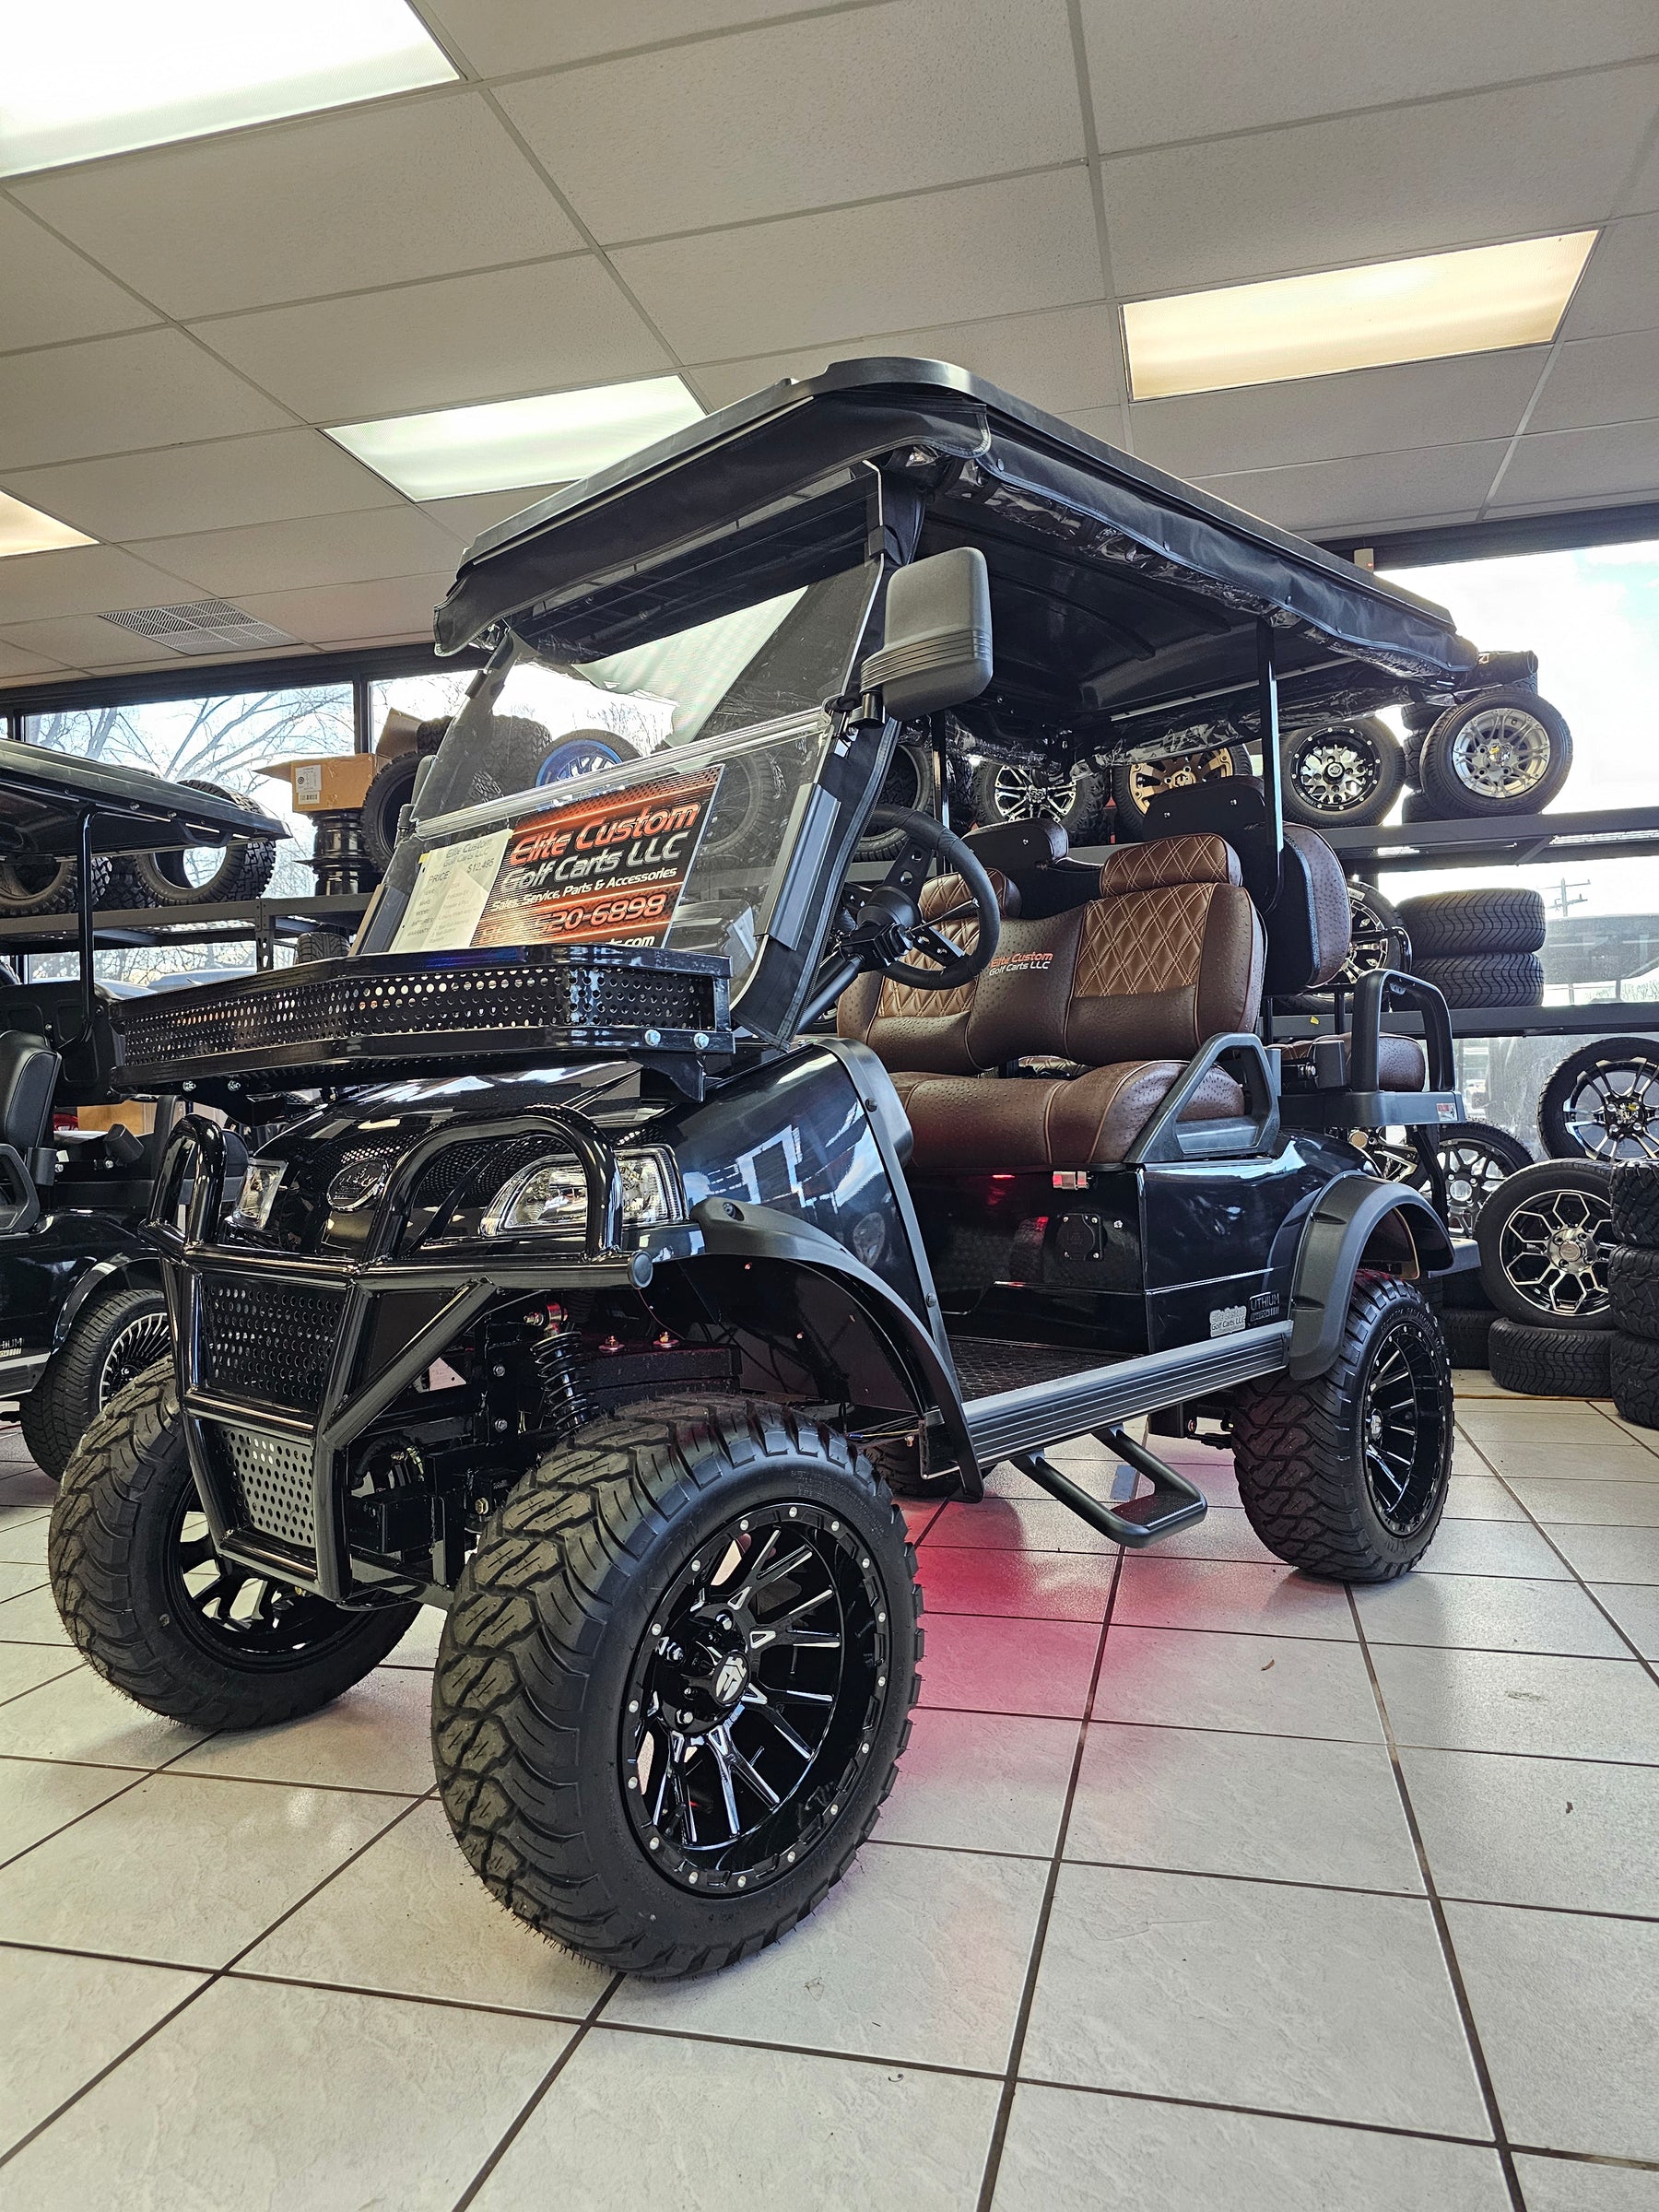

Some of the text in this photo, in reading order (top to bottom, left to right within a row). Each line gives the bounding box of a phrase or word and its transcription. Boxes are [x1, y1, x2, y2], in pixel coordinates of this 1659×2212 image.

[509, 801, 701, 866] Elite Custom
[463, 839, 493, 853] Custom
[500, 831, 690, 892] Golf Carts LLC
[523, 888, 561, 908] Service,
[563, 882, 593, 898] Parts
[594, 878, 606, 891] &
[606, 866, 678, 889] Accessories
[989, 951, 1053, 969] Elite Custom
[989, 960, 1051, 977] Golf Carts LLC
[1250, 1292, 1280, 1311] LITHIUM
